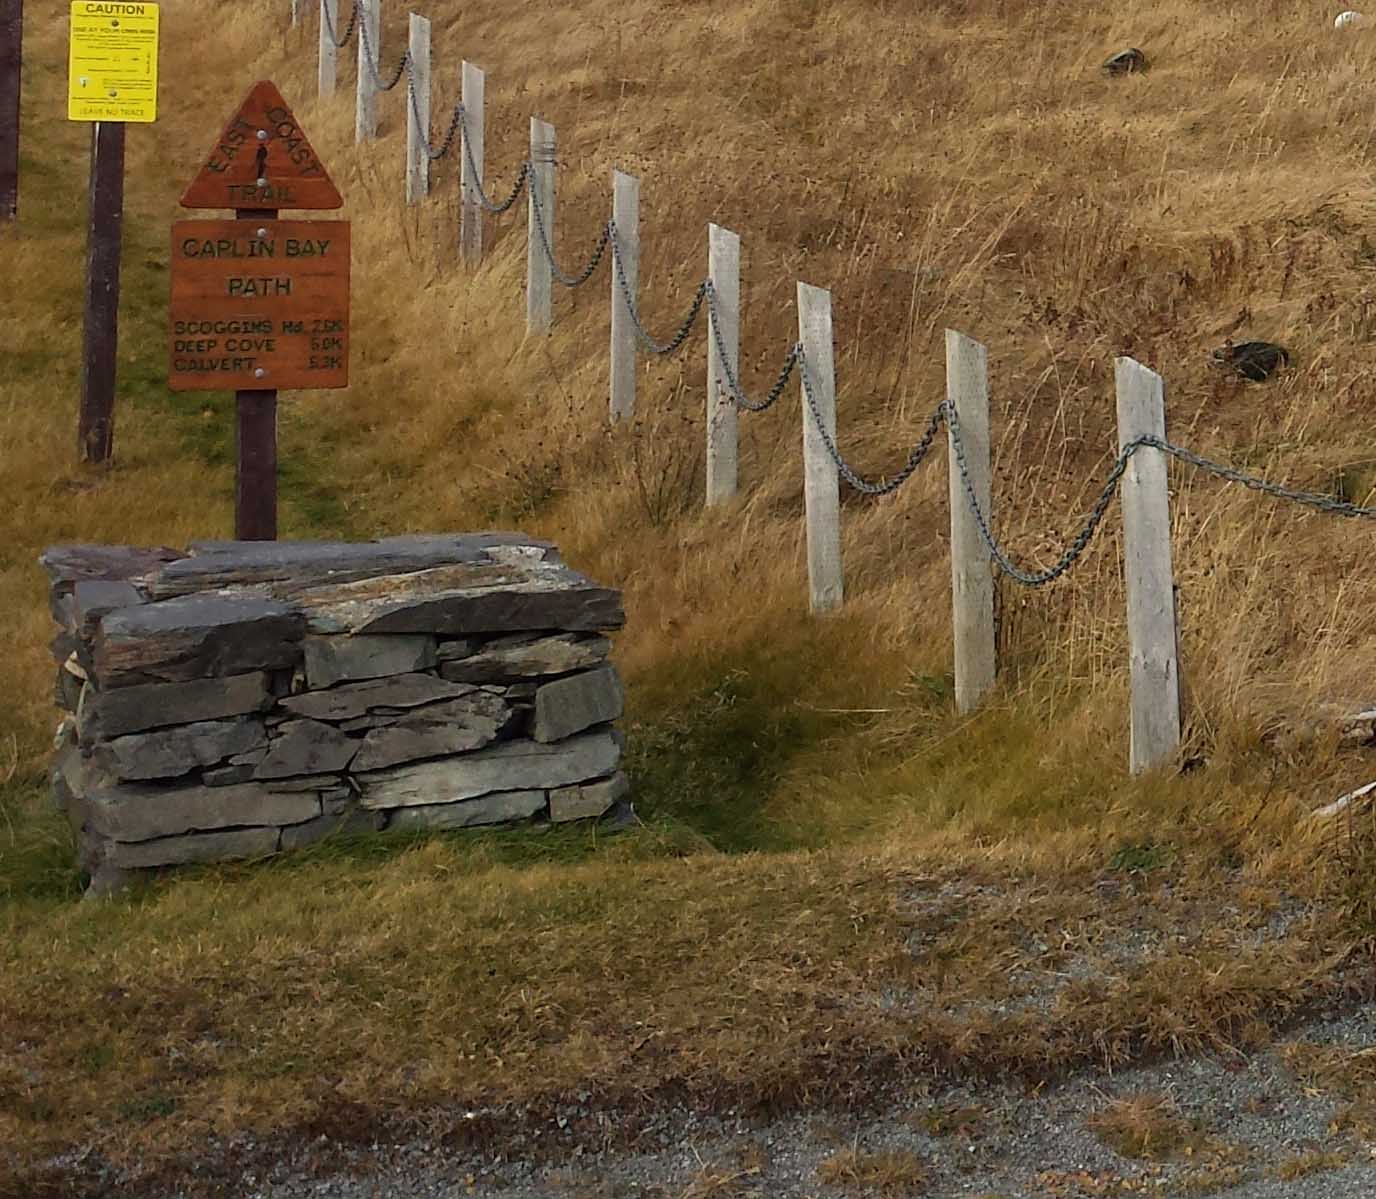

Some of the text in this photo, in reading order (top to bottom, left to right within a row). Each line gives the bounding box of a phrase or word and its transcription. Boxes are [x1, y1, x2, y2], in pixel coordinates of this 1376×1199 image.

[86, 3, 145, 15] CAUTION
[205, 116, 255, 176] EAST
[266, 104, 319, 176] COAST
[227, 184, 297, 202] TRAIL
[182, 238, 331, 258] CAPLIN BAY
[228, 277, 291, 296] PATH
[174, 338, 218, 352] DEEP
[225, 338, 276, 352] COVE
[174, 356, 257, 371] CALVERT
